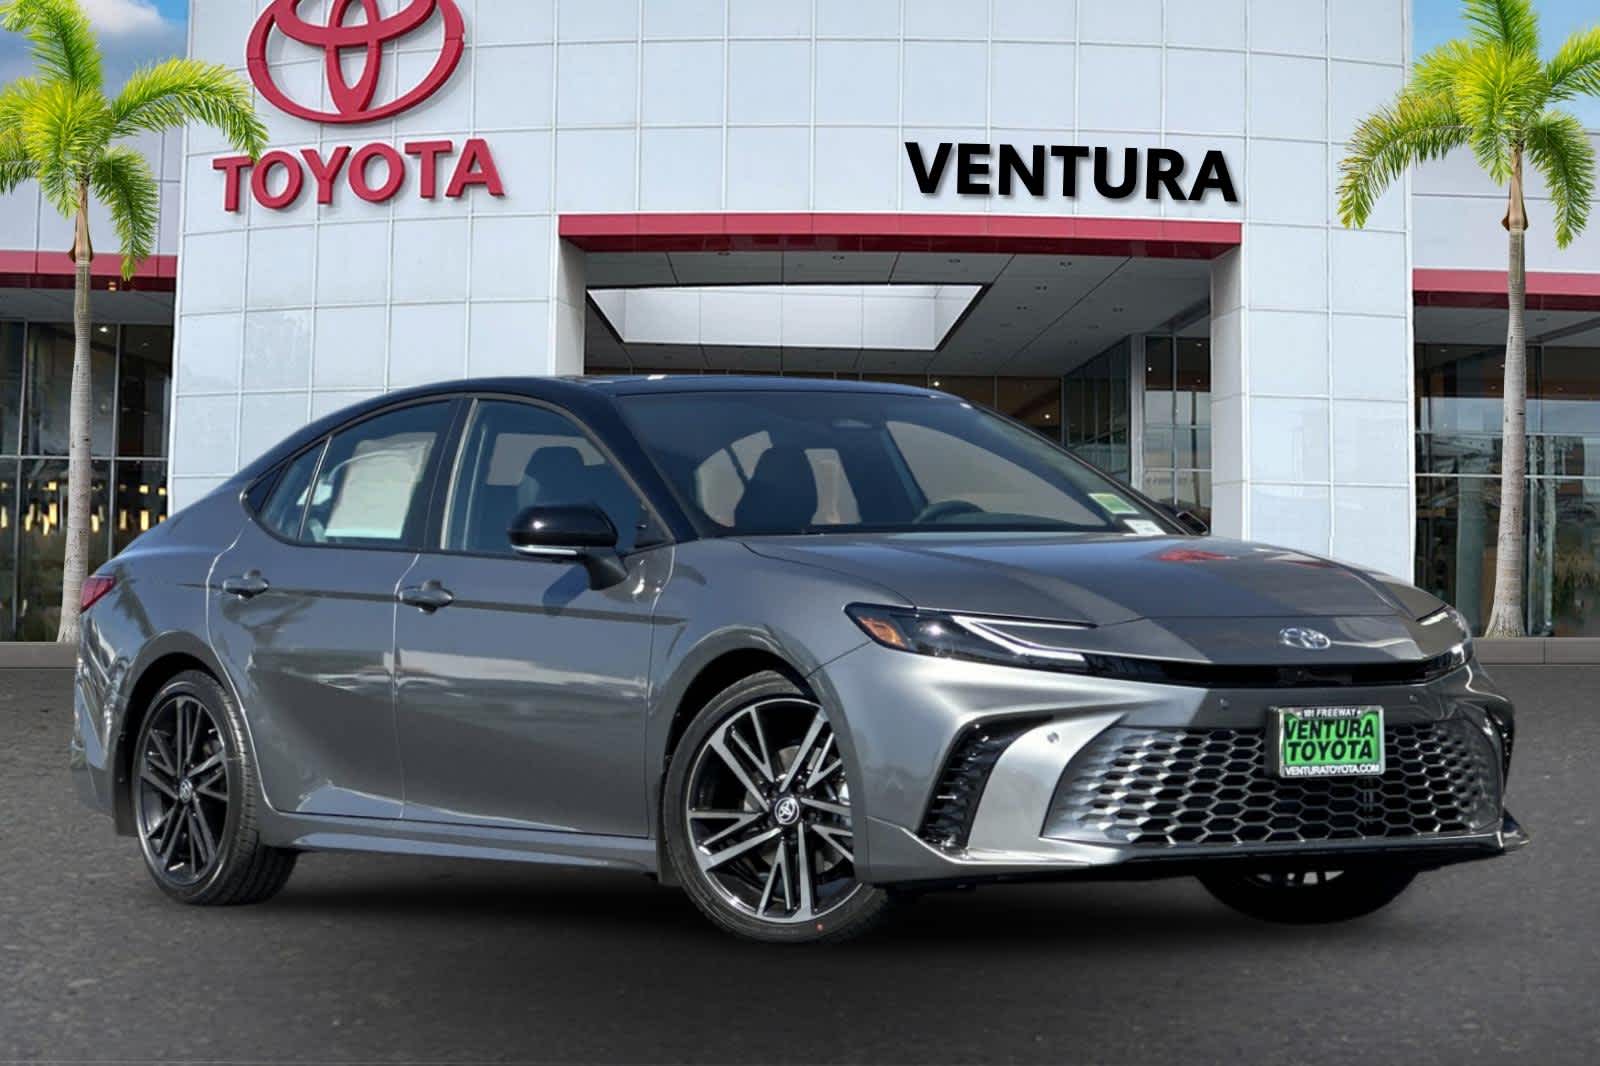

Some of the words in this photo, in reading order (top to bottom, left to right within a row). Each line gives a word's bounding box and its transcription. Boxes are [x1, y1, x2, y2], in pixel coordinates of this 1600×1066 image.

[213, 138, 504, 212] TOYOTA
[905, 142, 1239, 203] VENTURA
[1316, 708, 1357, 717] FREEWAY
[1284, 719, 1375, 739] VENTURA
[1287, 740, 1373, 761] TOYOTA
[1285, 764, 1380, 776] VENTURATOYOTA.COM
